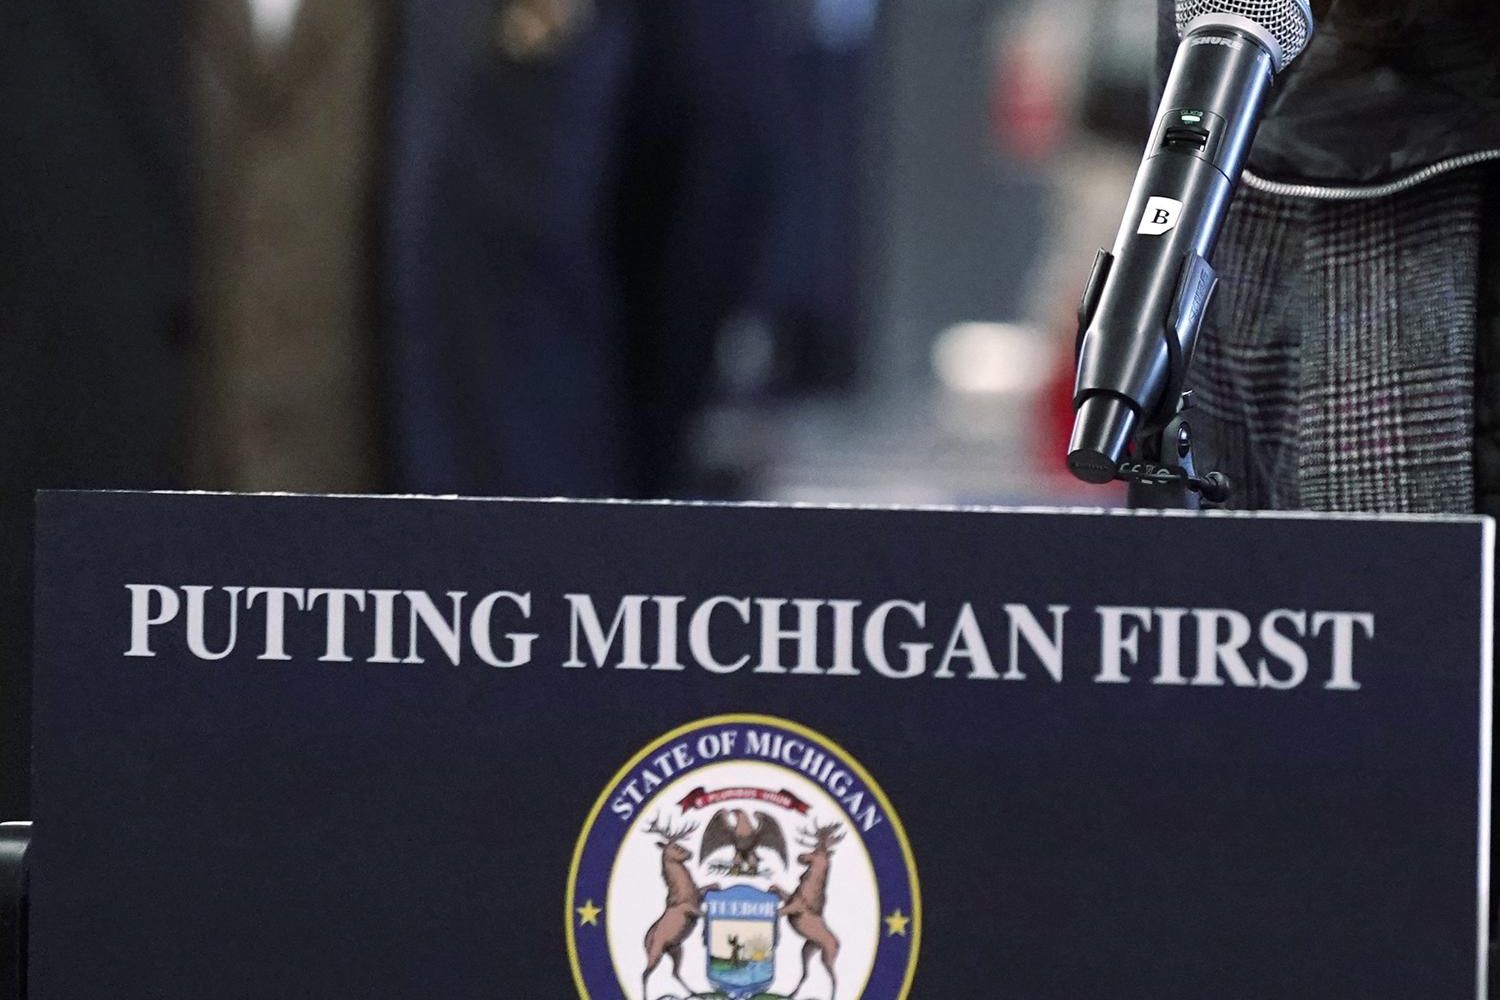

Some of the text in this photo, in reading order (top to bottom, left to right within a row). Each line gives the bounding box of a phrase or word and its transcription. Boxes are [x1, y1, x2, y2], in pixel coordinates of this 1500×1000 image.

[1150, 208, 1170, 224] B
[123, 583, 1375, 691] PUTTING MICHIGAN FIRST
[611, 730, 883, 833] STATE OF MICHIGAN
